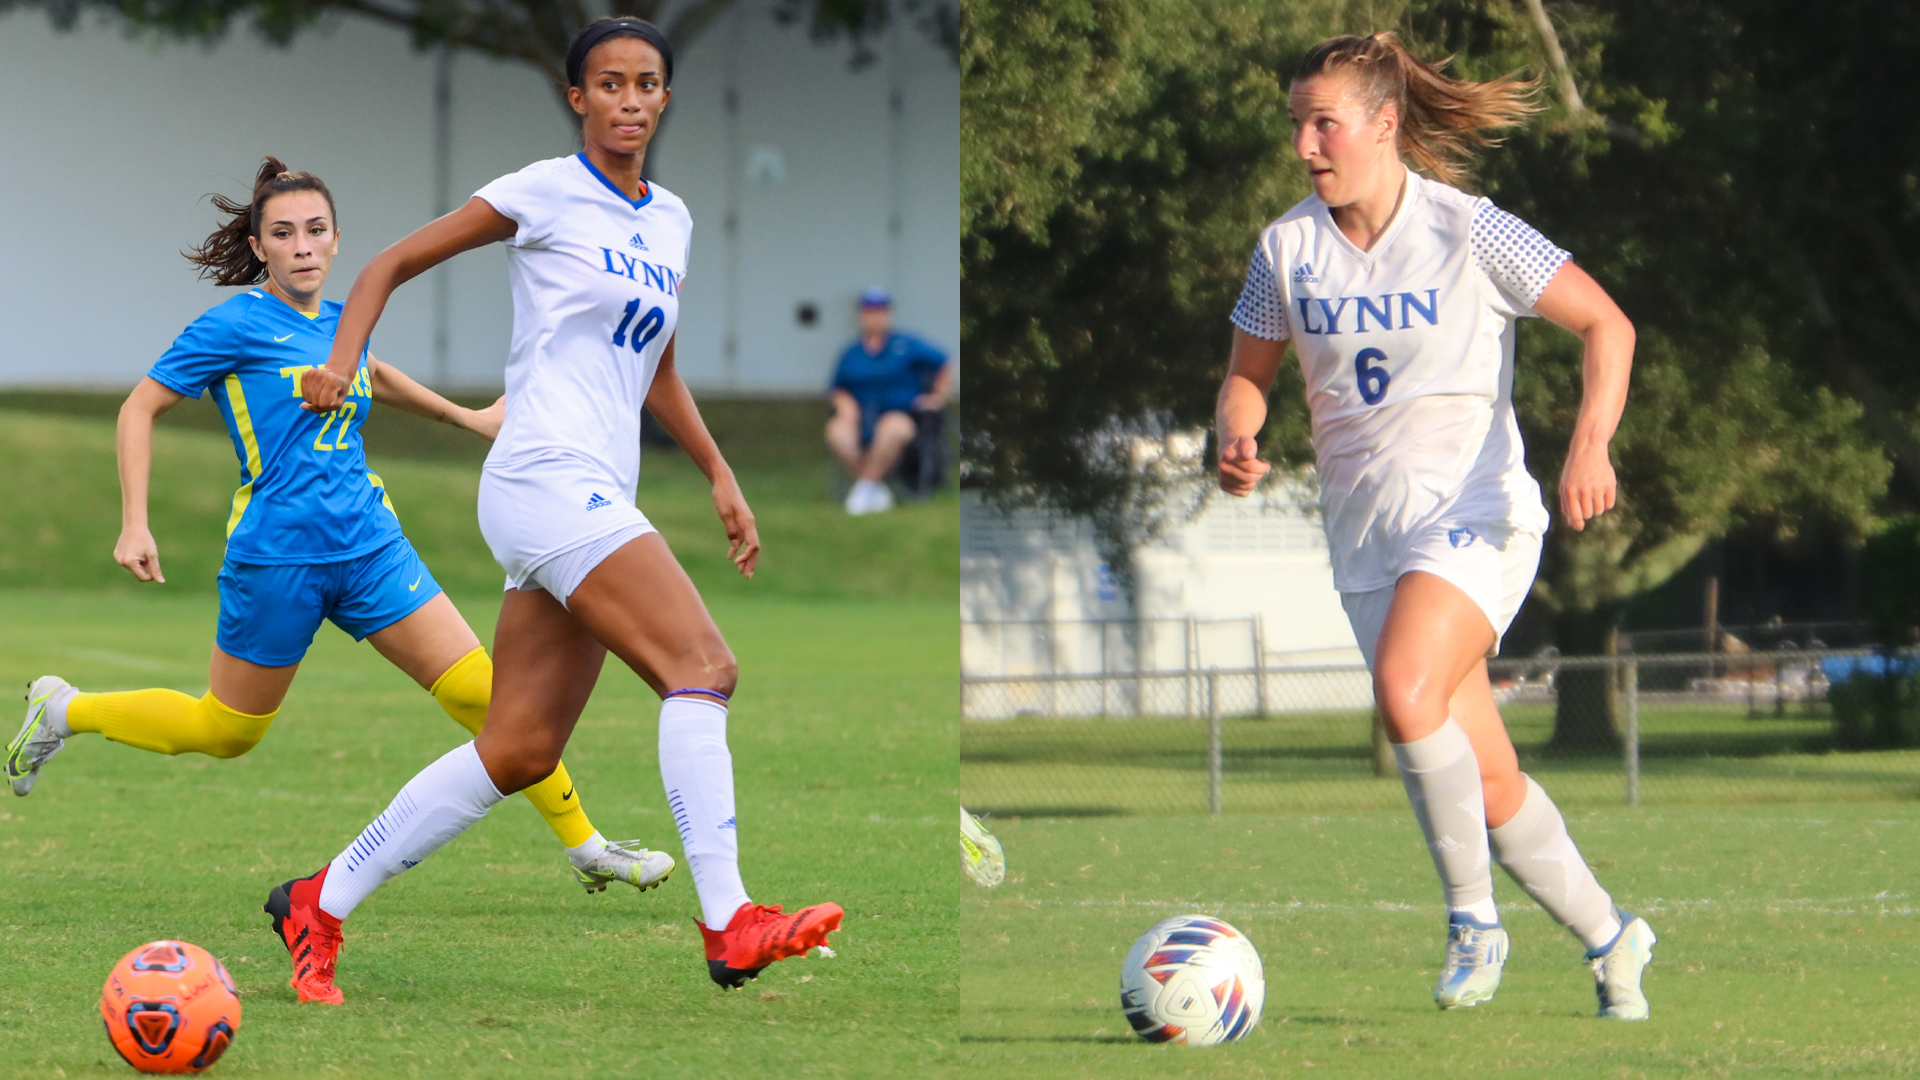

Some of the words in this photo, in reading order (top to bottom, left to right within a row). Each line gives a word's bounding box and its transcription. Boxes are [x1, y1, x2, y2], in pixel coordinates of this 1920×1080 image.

[599, 246, 680, 297] LYNN
[612, 298, 665, 353] 10
[1297, 288, 1440, 335] LYNN
[280, 364, 372, 398] TRS
[1355, 347, 1391, 406] 6
[313, 401, 357, 451] 22
